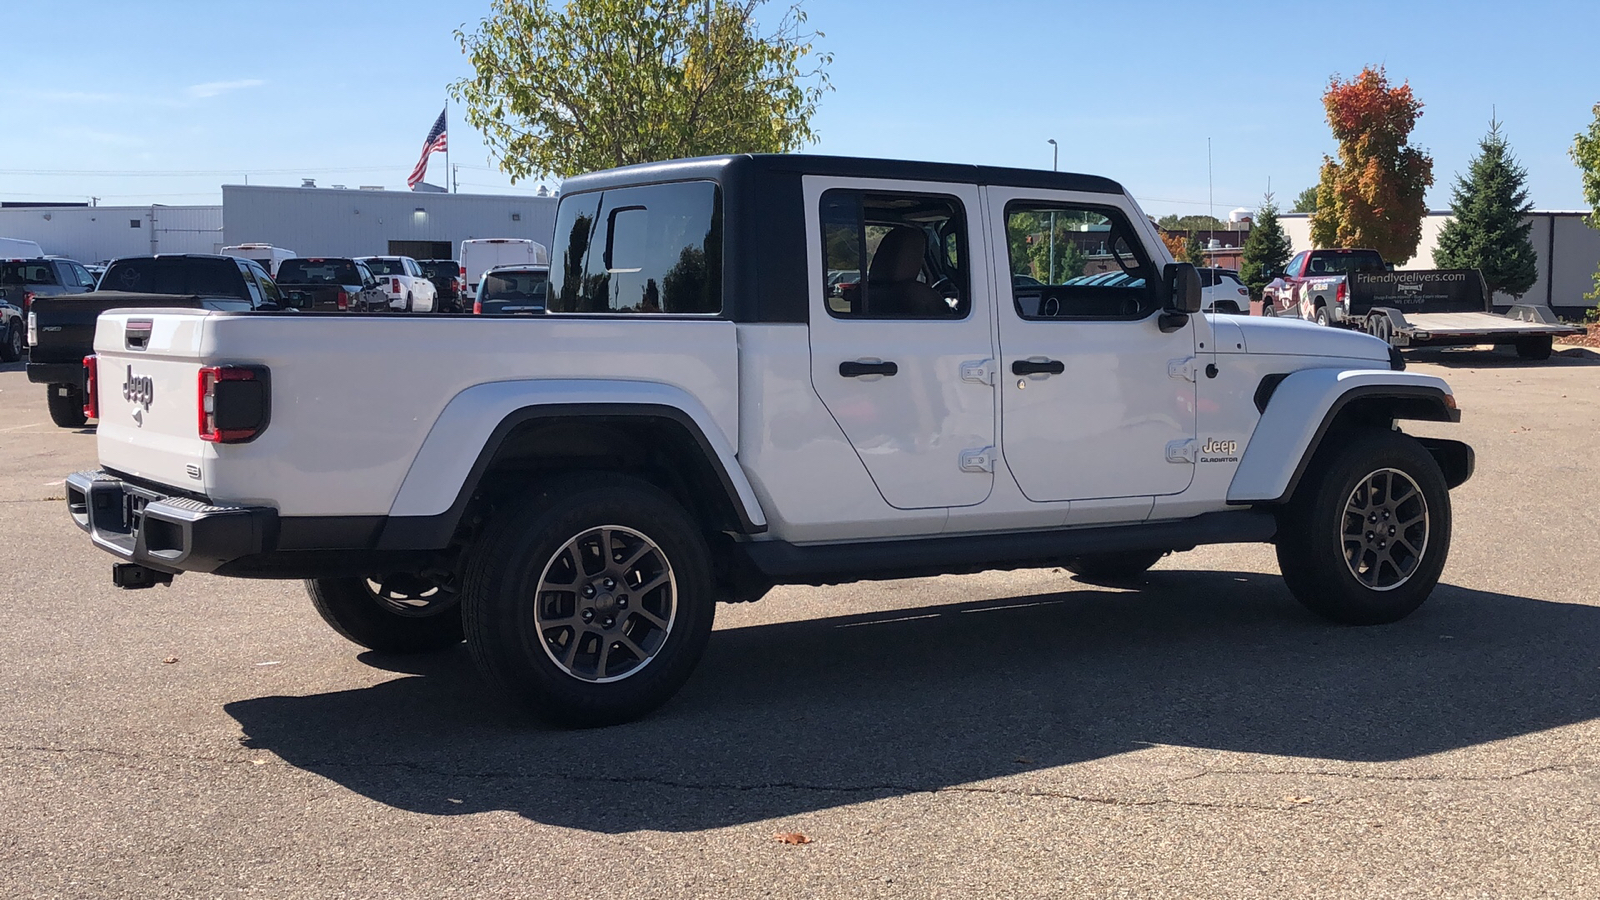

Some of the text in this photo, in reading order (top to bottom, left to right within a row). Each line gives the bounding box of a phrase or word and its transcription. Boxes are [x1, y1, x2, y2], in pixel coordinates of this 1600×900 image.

[1357, 273, 1466, 284] Friendlydelivers.com
[122, 364, 153, 413] Jeep
[1202, 437, 1237, 455] Jeep
